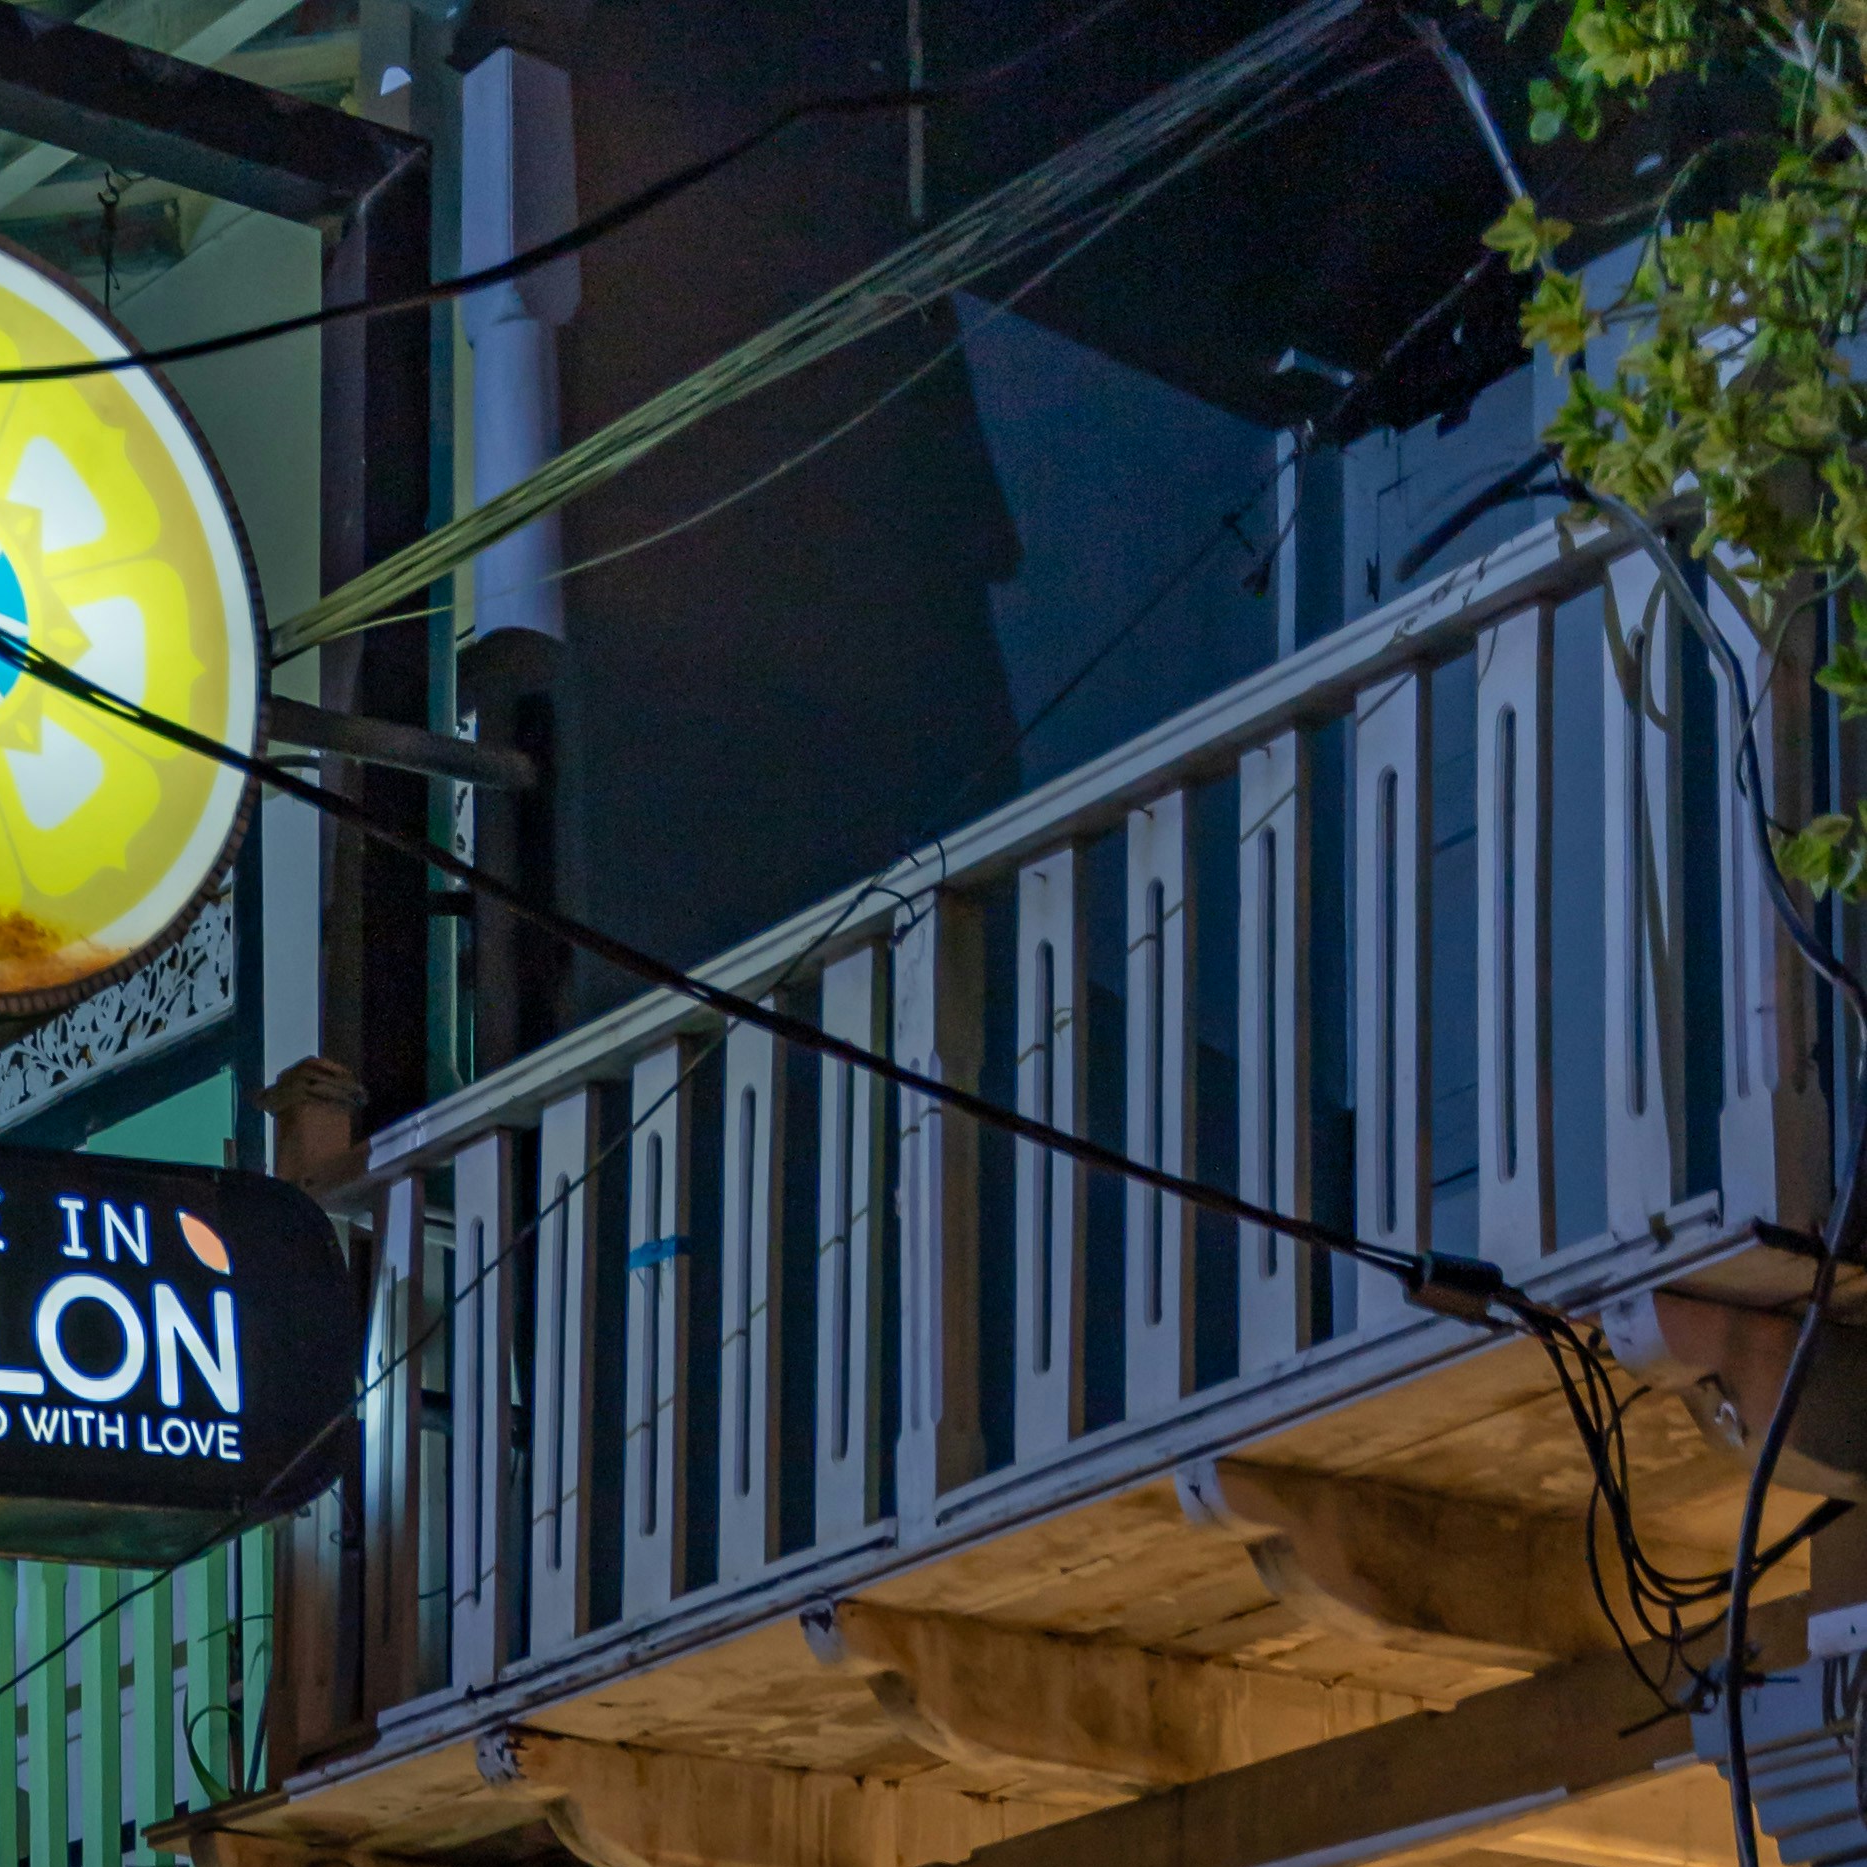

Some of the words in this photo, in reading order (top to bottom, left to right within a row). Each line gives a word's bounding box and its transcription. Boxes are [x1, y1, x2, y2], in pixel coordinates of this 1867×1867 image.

[60, 1198, 153, 1265] IN
[21, 1404, 127, 1450] WITH
[141, 1417, 242, 1461] LOVE
